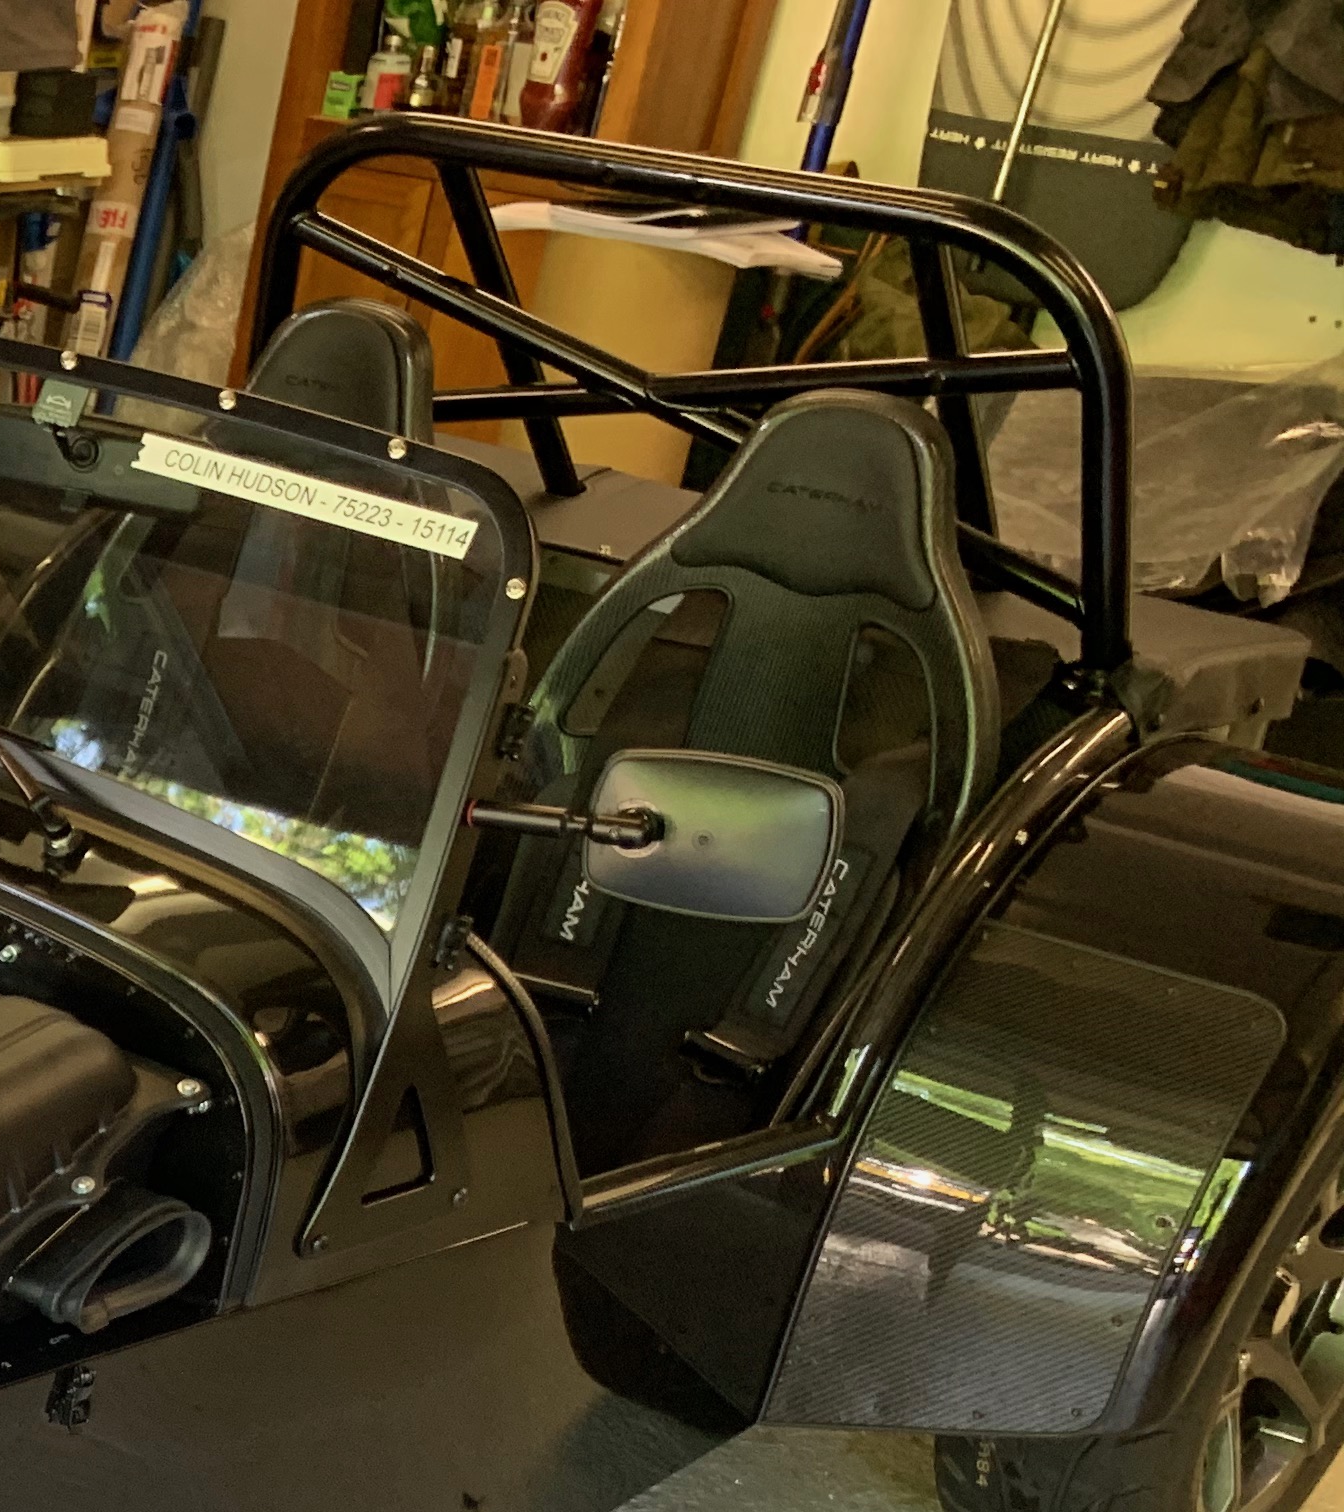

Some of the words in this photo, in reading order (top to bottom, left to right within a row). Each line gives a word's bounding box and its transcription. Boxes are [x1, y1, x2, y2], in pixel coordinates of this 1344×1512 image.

[990, 138, 1078, 161] RESISTT
[164, 448, 227, 483] COLIN
[227, 467, 318, 508] HUDSON
[331, 494, 392, 529] 75223
[412, 515, 471, 550] 15114
[765, 858, 849, 1008] CATERHAM
